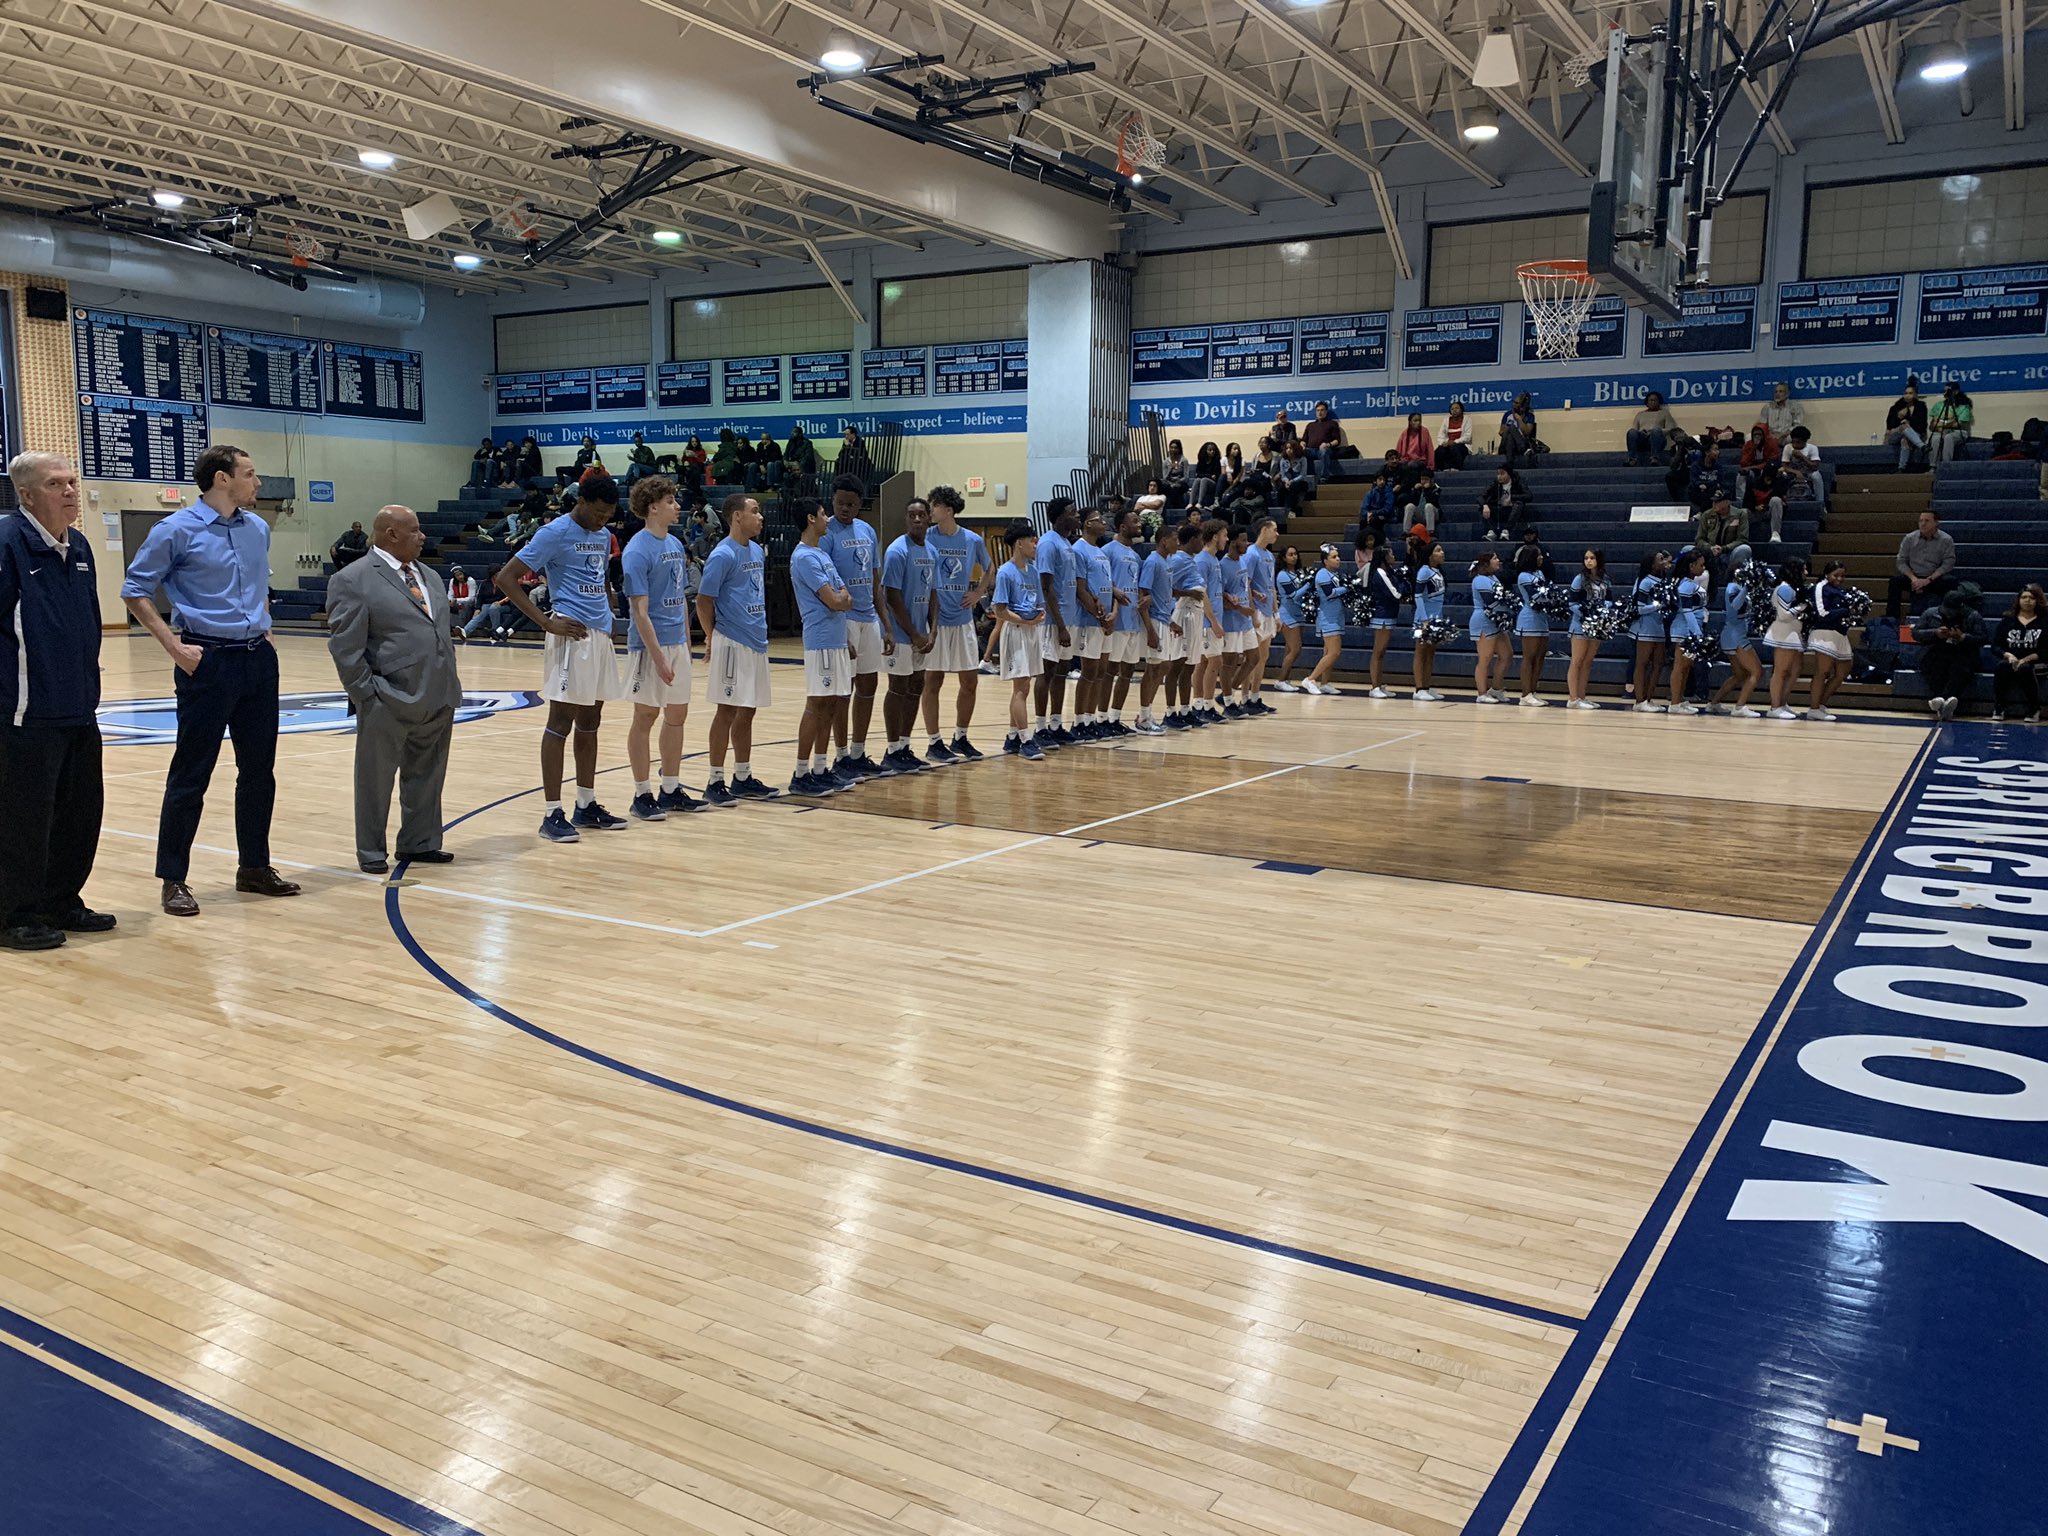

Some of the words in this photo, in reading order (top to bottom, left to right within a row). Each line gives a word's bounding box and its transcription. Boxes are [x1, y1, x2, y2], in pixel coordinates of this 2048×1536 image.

[1818, 280, 1898, 296] VOLLEYBALL
[1963, 286, 2005, 298] DIVISION
[1723, 290, 1754, 303] FIELD
[1818, 296, 1858, 306] DIVISION
[1930, 293, 2039, 312] CHAMPIONS
[1682, 306, 1716, 316] REGION
[1788, 303, 1889, 320] CHAMPIONS
[1948, 313, 1966, 321] 1987
[1361, 316, 1386, 328] FIELD
[1436, 322, 1468, 331] DIVISION
[1875, 317, 1892, 325] 2011
[1328, 330, 1356, 338] REGION
[1412, 328, 1492, 344] CHAMPIONS
[1585, 334, 1600, 342] 2002
[1668, 330, 1684, 338] 1977
[1158, 342, 1184, 350] DIVISION
[1238, 336, 1266, 345] DIVISION
[1306, 336, 1380, 350] CHAMPIONS
[1138, 348, 1204, 360] CHAMPIONS
[1218, 342, 1287, 357] CHAMPIONS
[729, 359, 774, 370] SOFTBALL
[796, 355, 844, 366] SOFTBALL
[956, 356, 978, 364] DIVISION
[867, 366, 921, 378] CHAMPIONS
[940, 362, 996, 374] CHAMPIONS
[728, 374, 776, 386] CHAMPIONS
[796, 371, 846, 382] CHAMPIONS
[599, 382, 642, 392] CHAMPIONS
[662, 378, 707, 389] CHAMPIONS
[1594, 382, 1649, 402] Blue
[1670, 374, 1754, 400] Devils
[1794, 368, 1866, 391] expect
[94, 396, 130, 410] STATE
[132, 400, 193, 415] CHAMPIONS
[1194, 400, 1256, 420] Devils
[1366, 392, 1420, 408] believe
[1450, 387, 1512, 406] achieve
[796, 419, 828, 435] Blue
[904, 414, 942, 430] expect
[964, 410, 1004, 426] believe
[664, 424, 696, 436] believe
[2006, 629, 2042, 643] SLAY
[1726, 755, 2048, 1265] SPRINGBROOK
